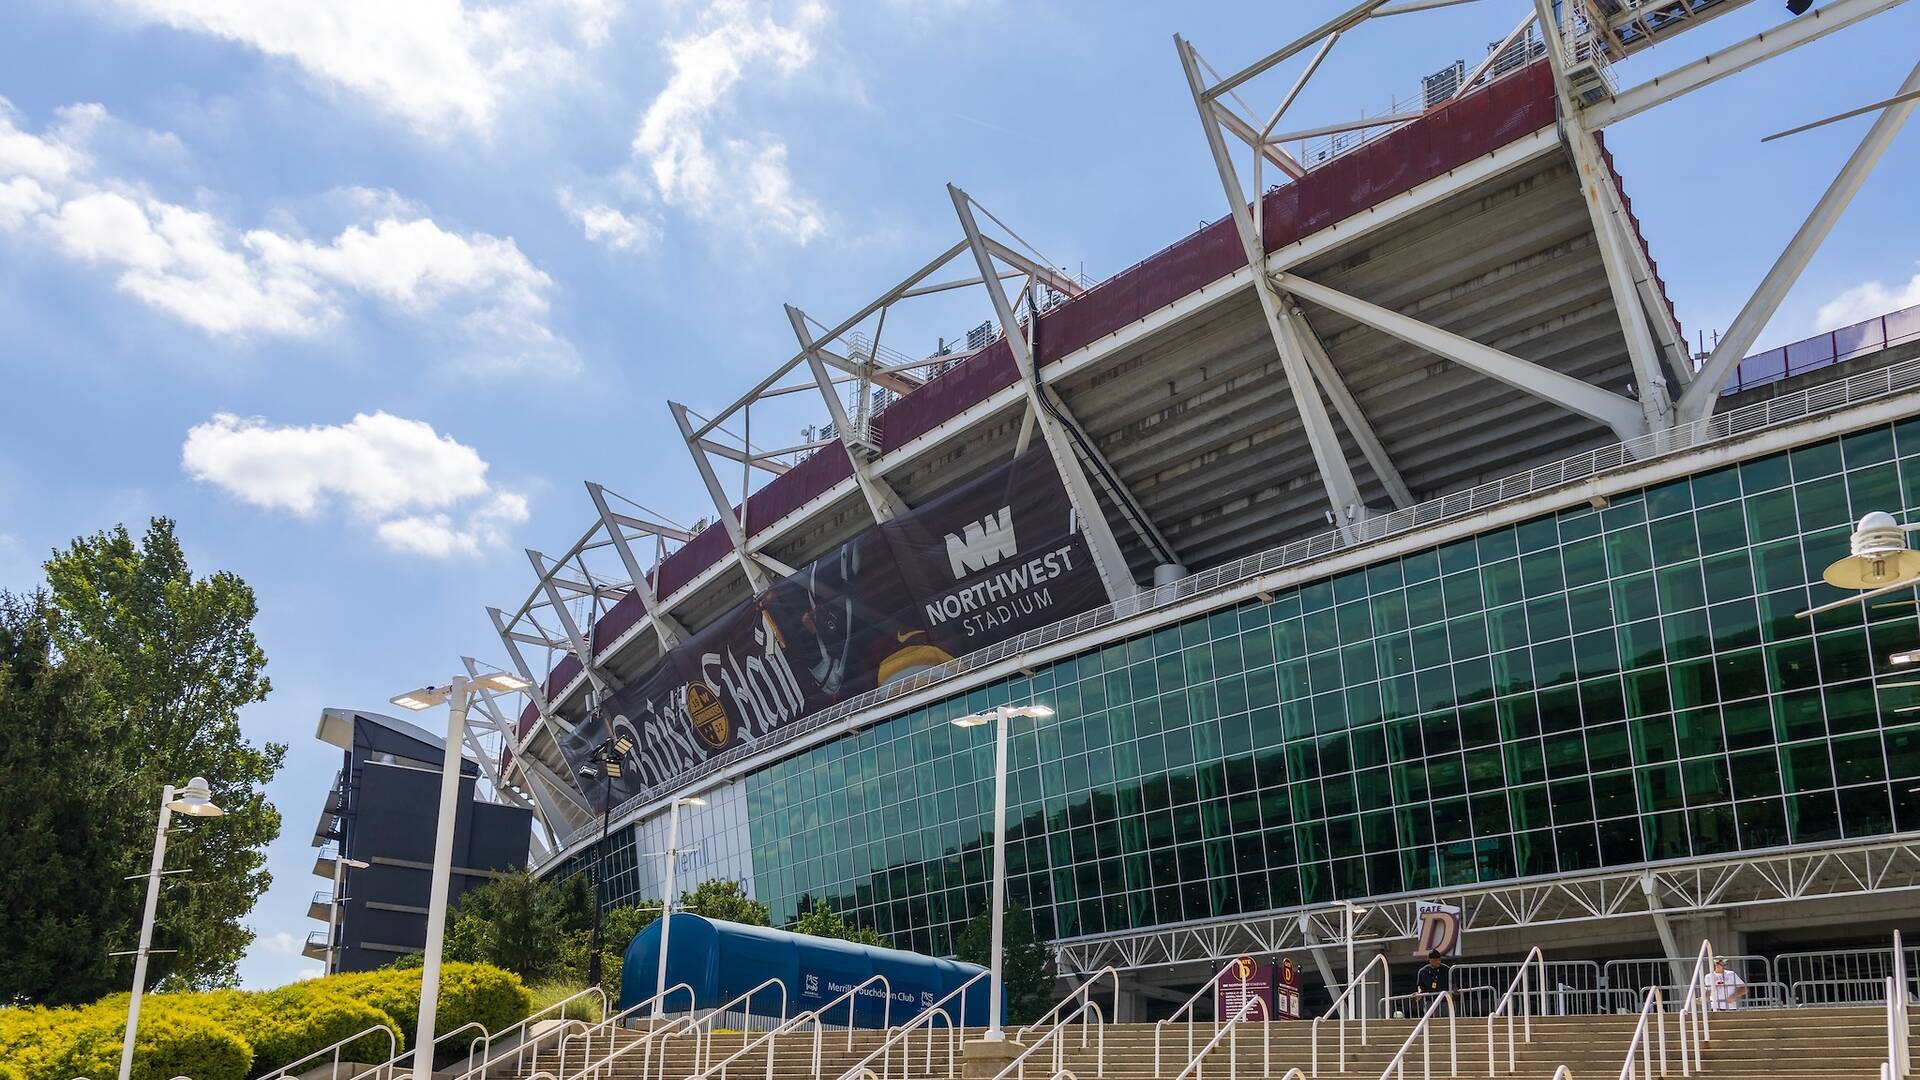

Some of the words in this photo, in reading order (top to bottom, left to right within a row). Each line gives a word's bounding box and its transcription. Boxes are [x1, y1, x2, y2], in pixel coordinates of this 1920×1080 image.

[944, 505, 1017, 580] NW
[925, 545, 1073, 626] NORTHWEST
[963, 587, 1053, 637] STADIUM
[702, 610, 805, 751] Hail
[1420, 905, 1441, 913] GATE
[1413, 911, 1457, 960] D
[828, 981, 852, 993] Merrill
[897, 992, 915, 1003] Club
